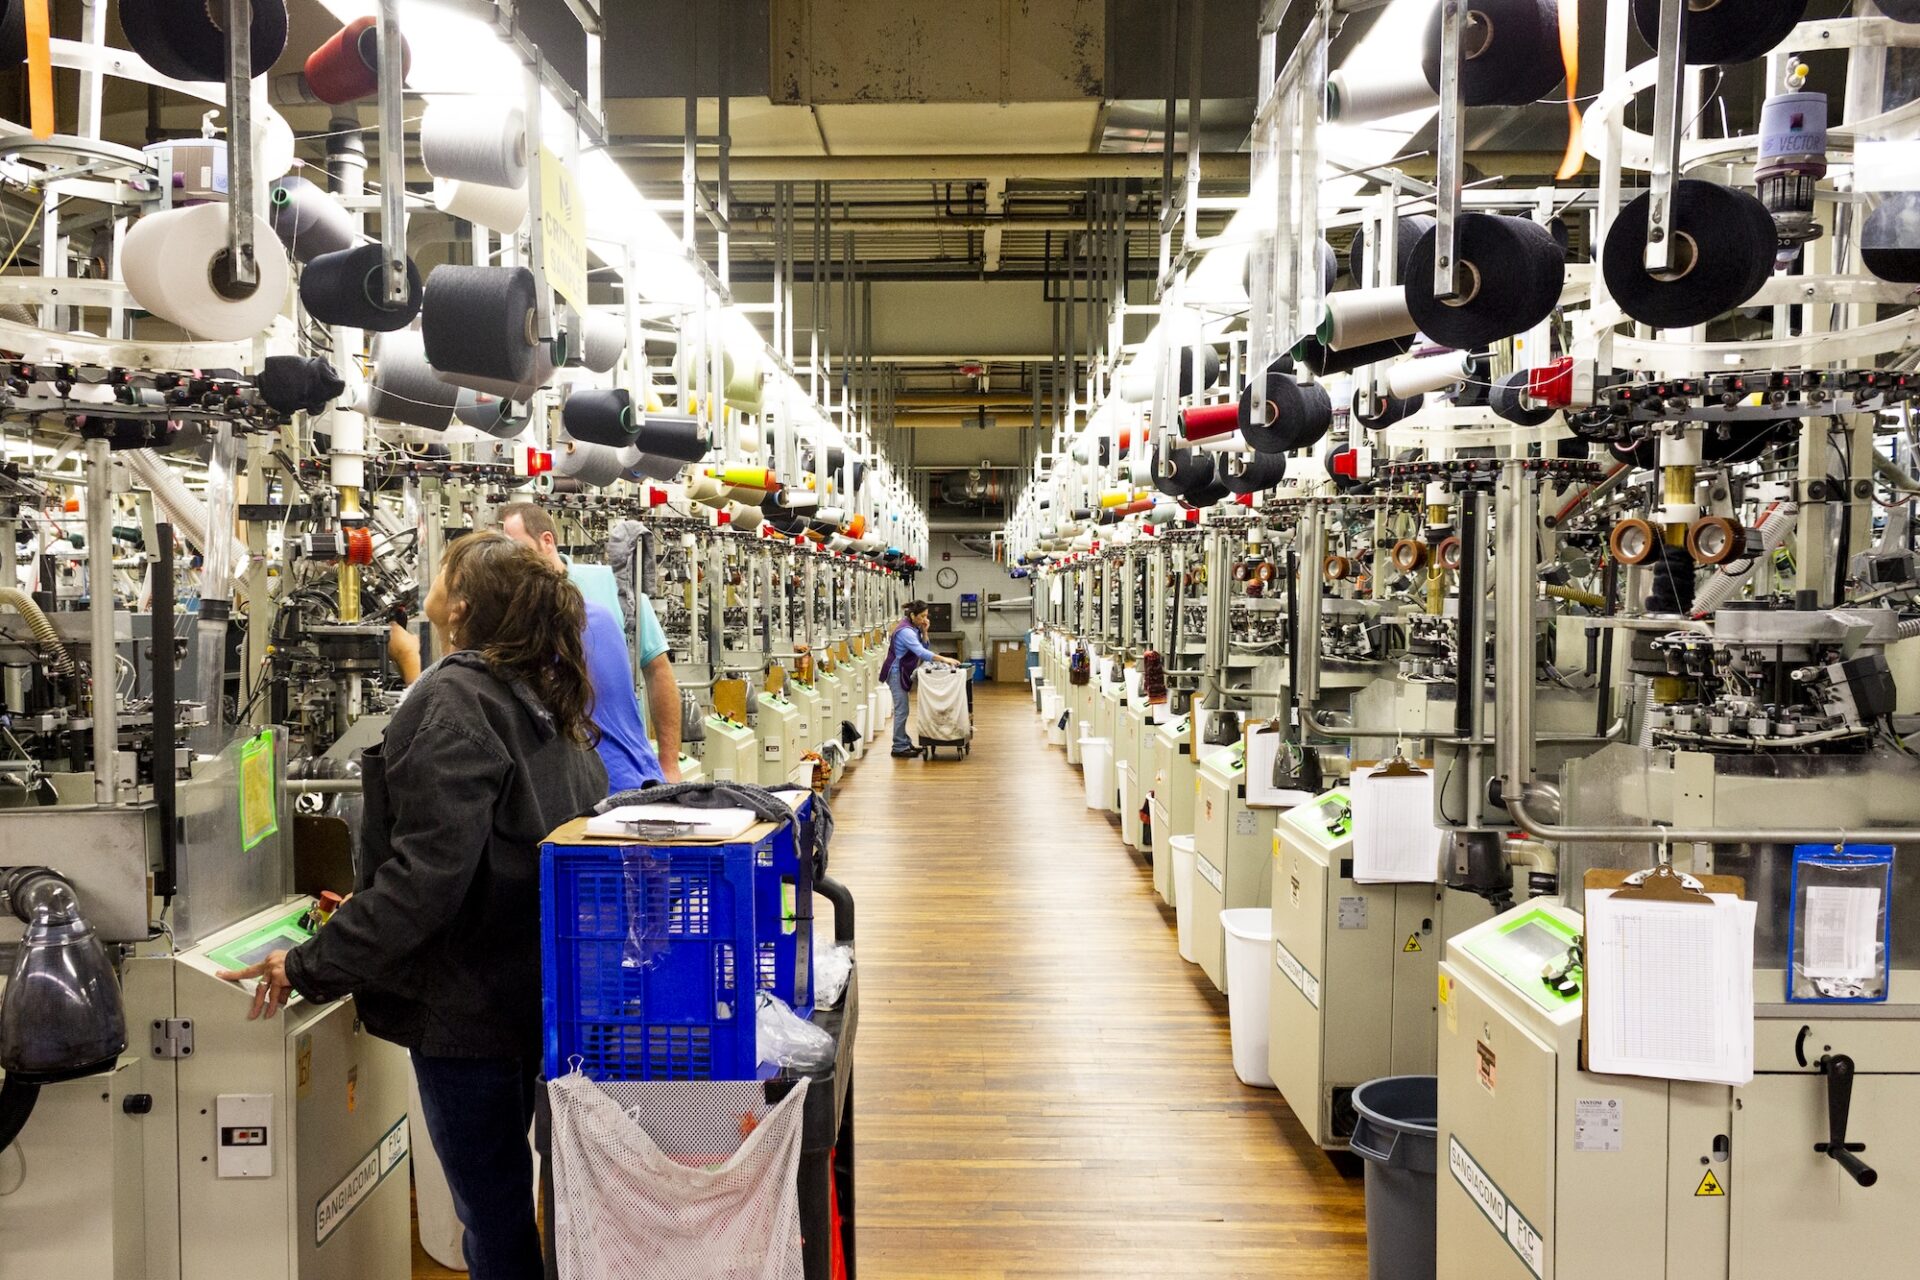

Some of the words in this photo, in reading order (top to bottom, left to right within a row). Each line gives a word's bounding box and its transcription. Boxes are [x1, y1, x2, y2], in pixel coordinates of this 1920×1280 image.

[1779, 136, 1820, 152] VECTOR
[545, 211, 585, 273] CRITICAL
[318, 1158, 377, 1231] SANGIACOMO
[1451, 1146, 1503, 1221] SANGIACOMO
[1517, 1218, 1534, 1251] F1C
